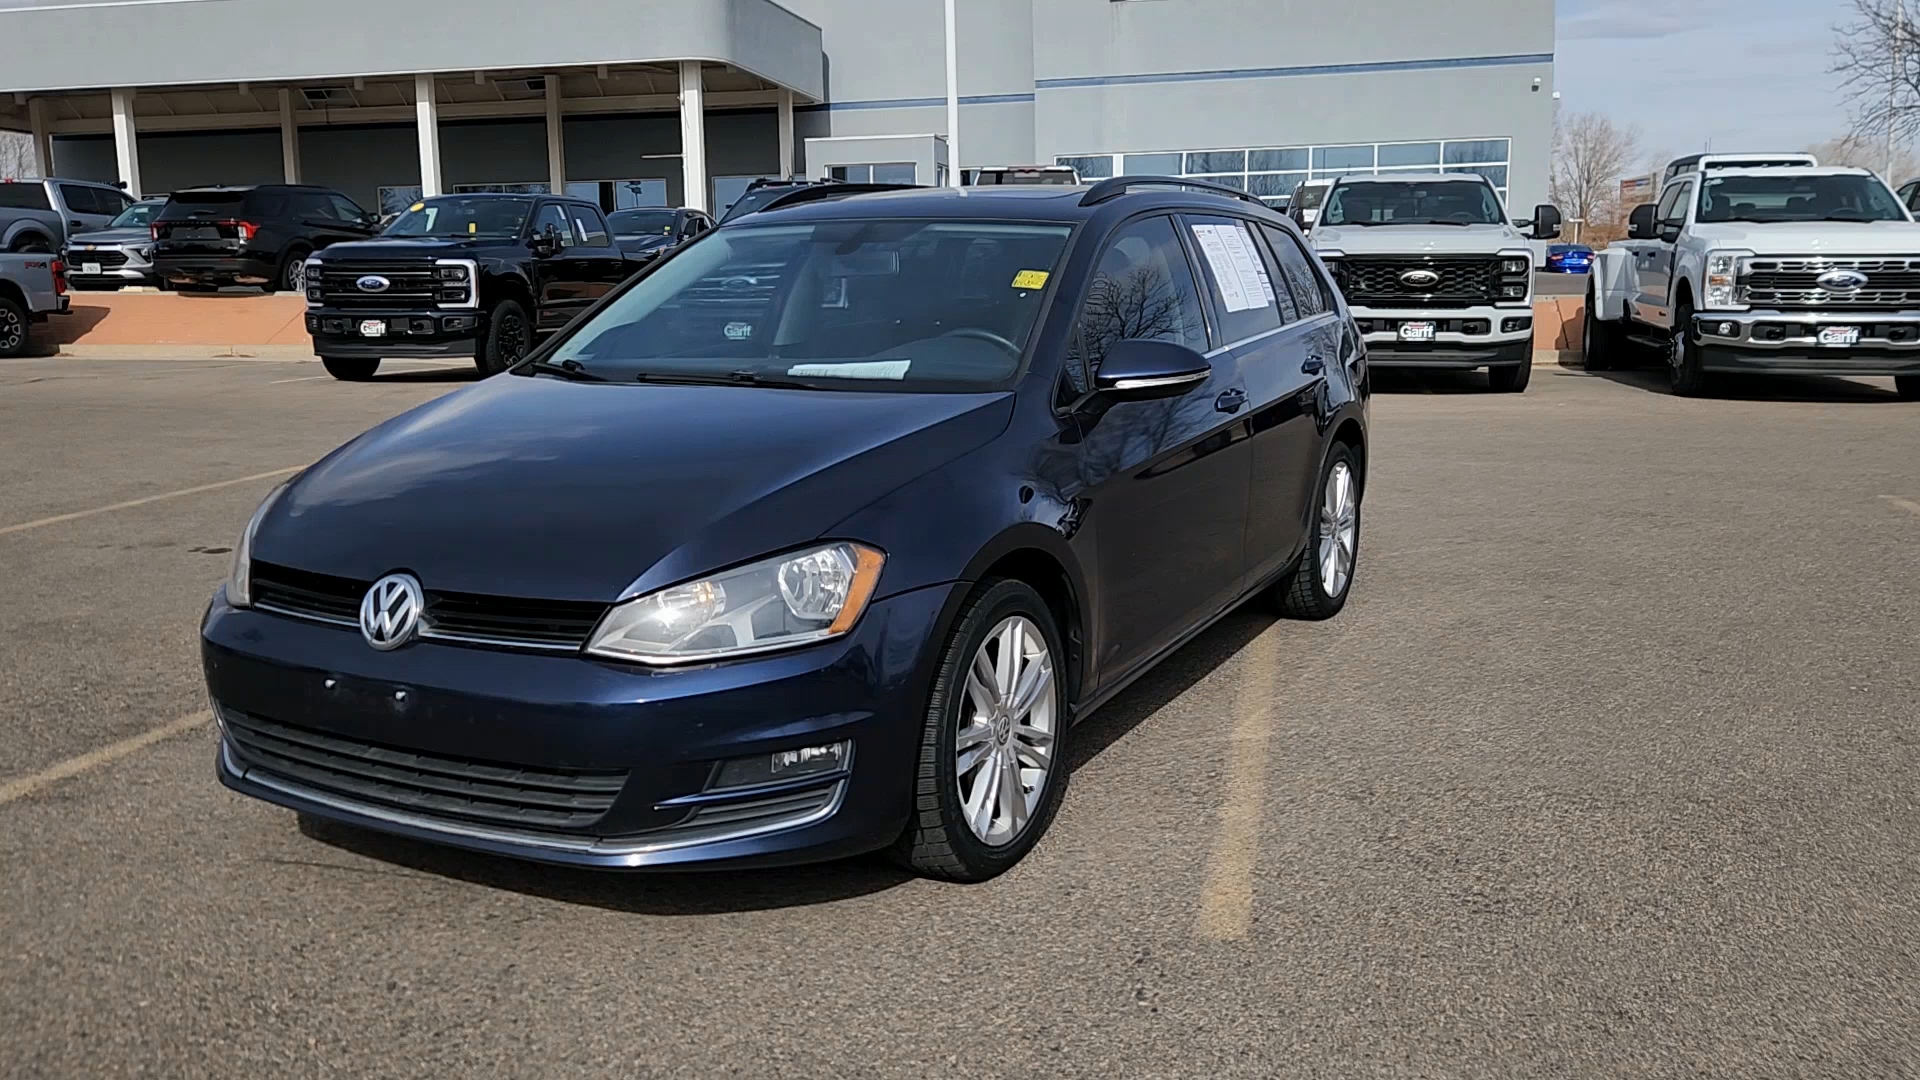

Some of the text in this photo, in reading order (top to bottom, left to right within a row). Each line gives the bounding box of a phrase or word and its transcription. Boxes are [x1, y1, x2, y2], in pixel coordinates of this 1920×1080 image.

[723, 324, 752, 337] Garff
[1400, 325, 1434, 338] Garff
[1818, 328, 1859, 343] Garff
